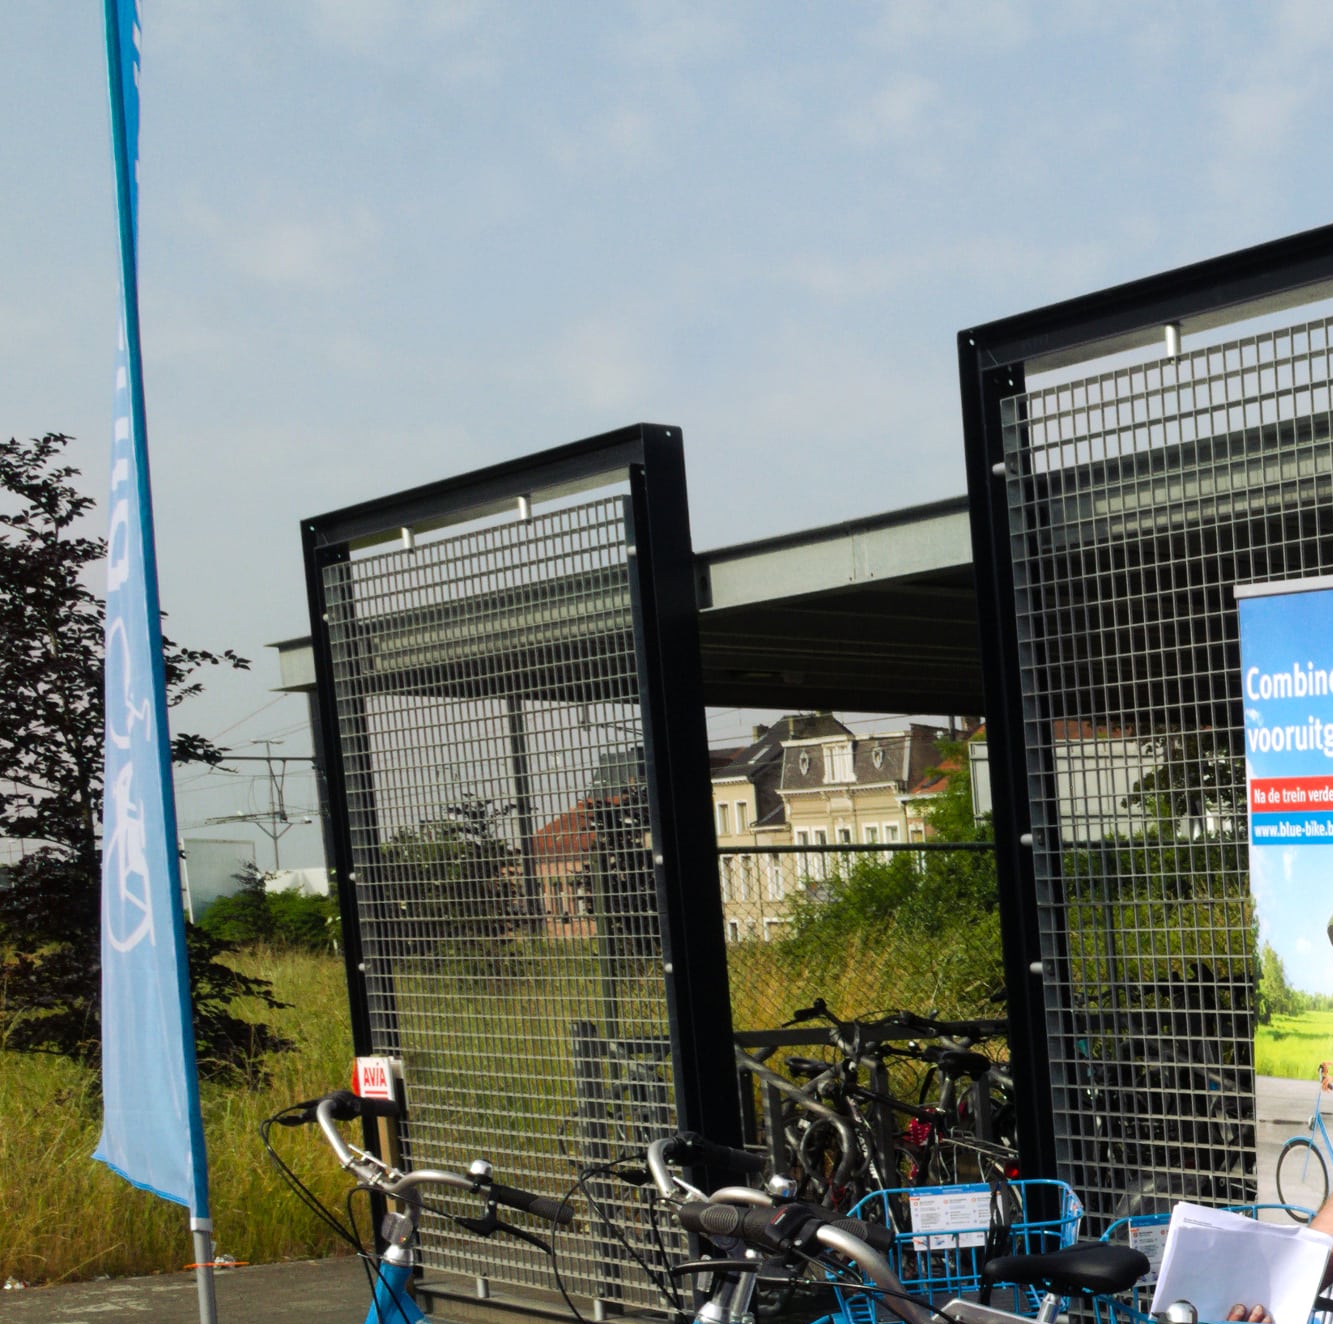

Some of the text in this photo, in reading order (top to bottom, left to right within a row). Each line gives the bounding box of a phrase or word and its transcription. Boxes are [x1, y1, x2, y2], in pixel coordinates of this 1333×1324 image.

[1254, 789, 1266, 804] Na
[1268, 787, 1280, 803] de
[1282, 786, 1306, 803] trein
[364, 1066, 387, 1087] AVIA
